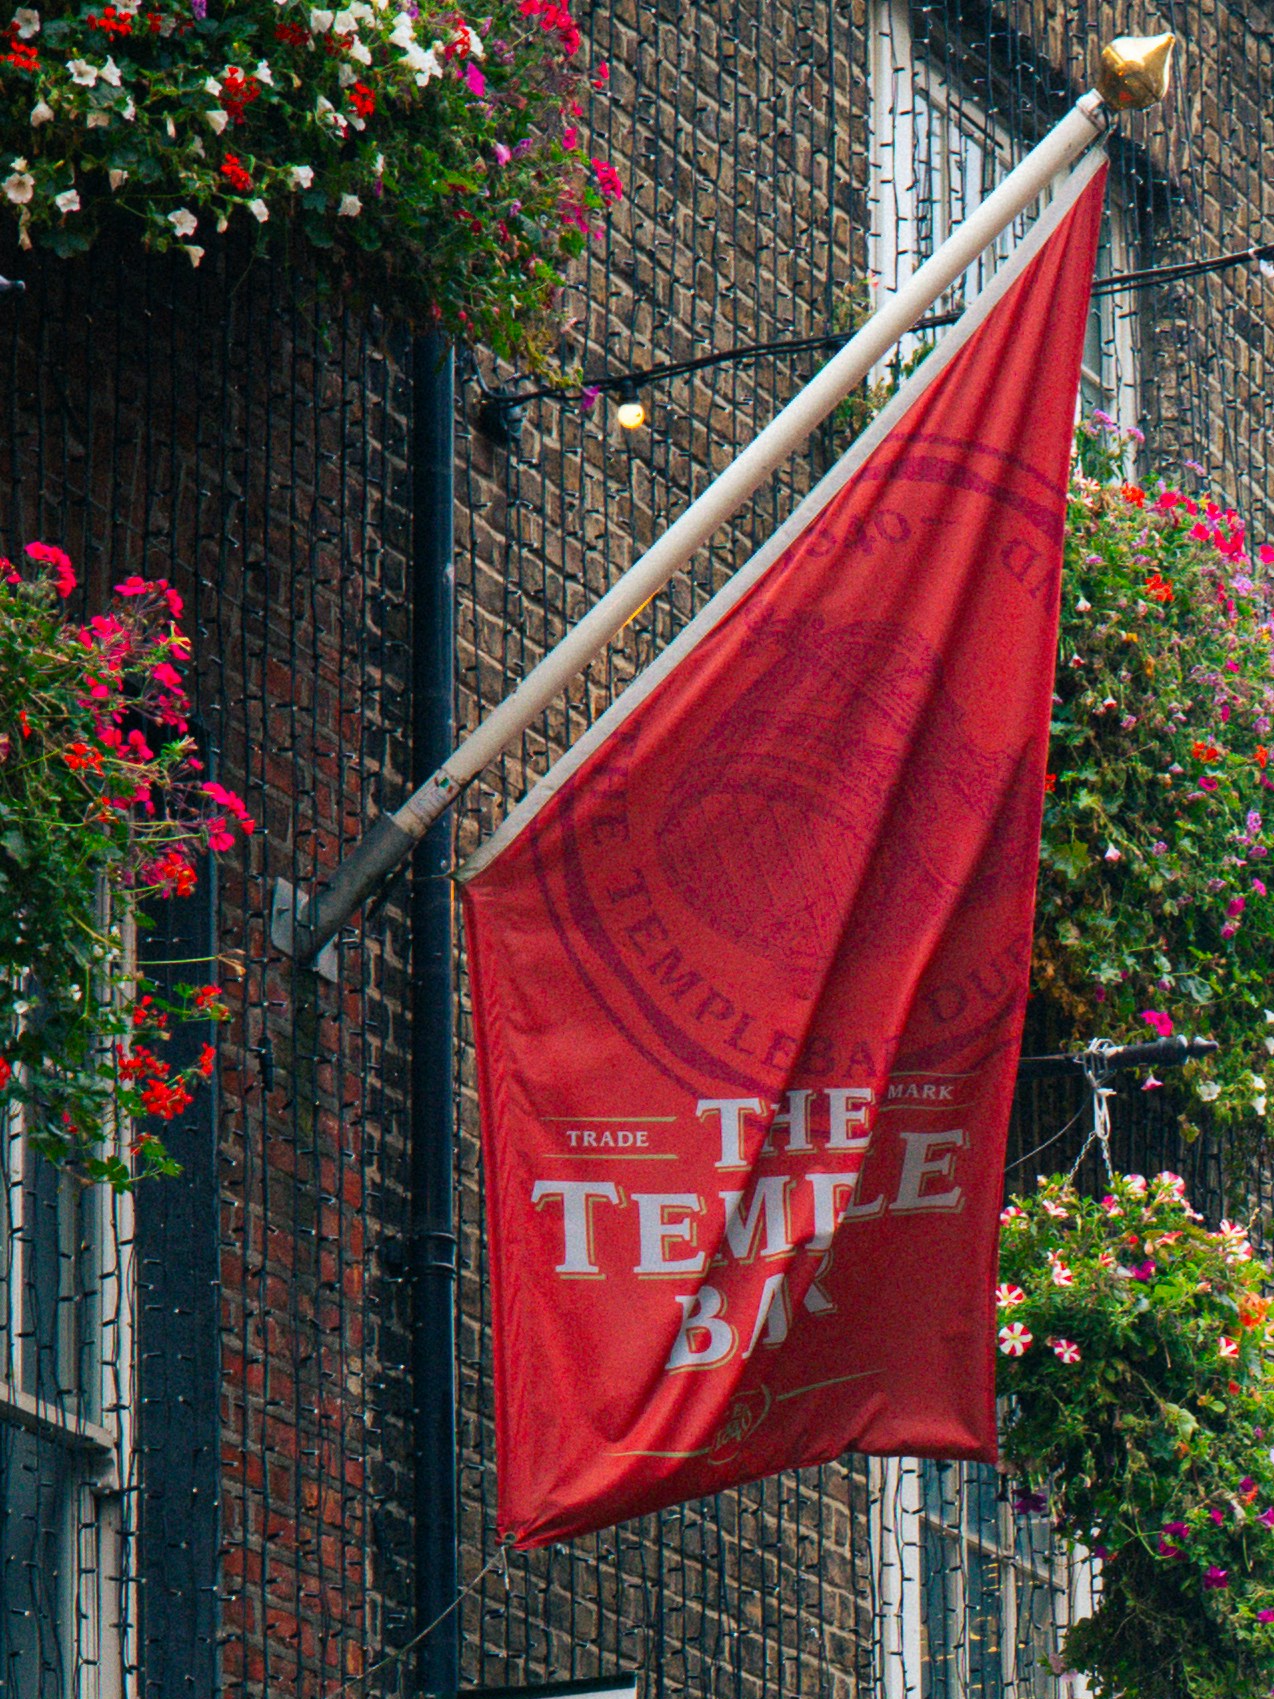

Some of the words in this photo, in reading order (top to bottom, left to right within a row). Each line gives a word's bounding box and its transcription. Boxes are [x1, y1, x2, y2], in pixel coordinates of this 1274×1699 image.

[886, 1082, 955, 1102] MARK
[566, 1129, 650, 1149] TRADE
[696, 1086, 879, 1173] THE
